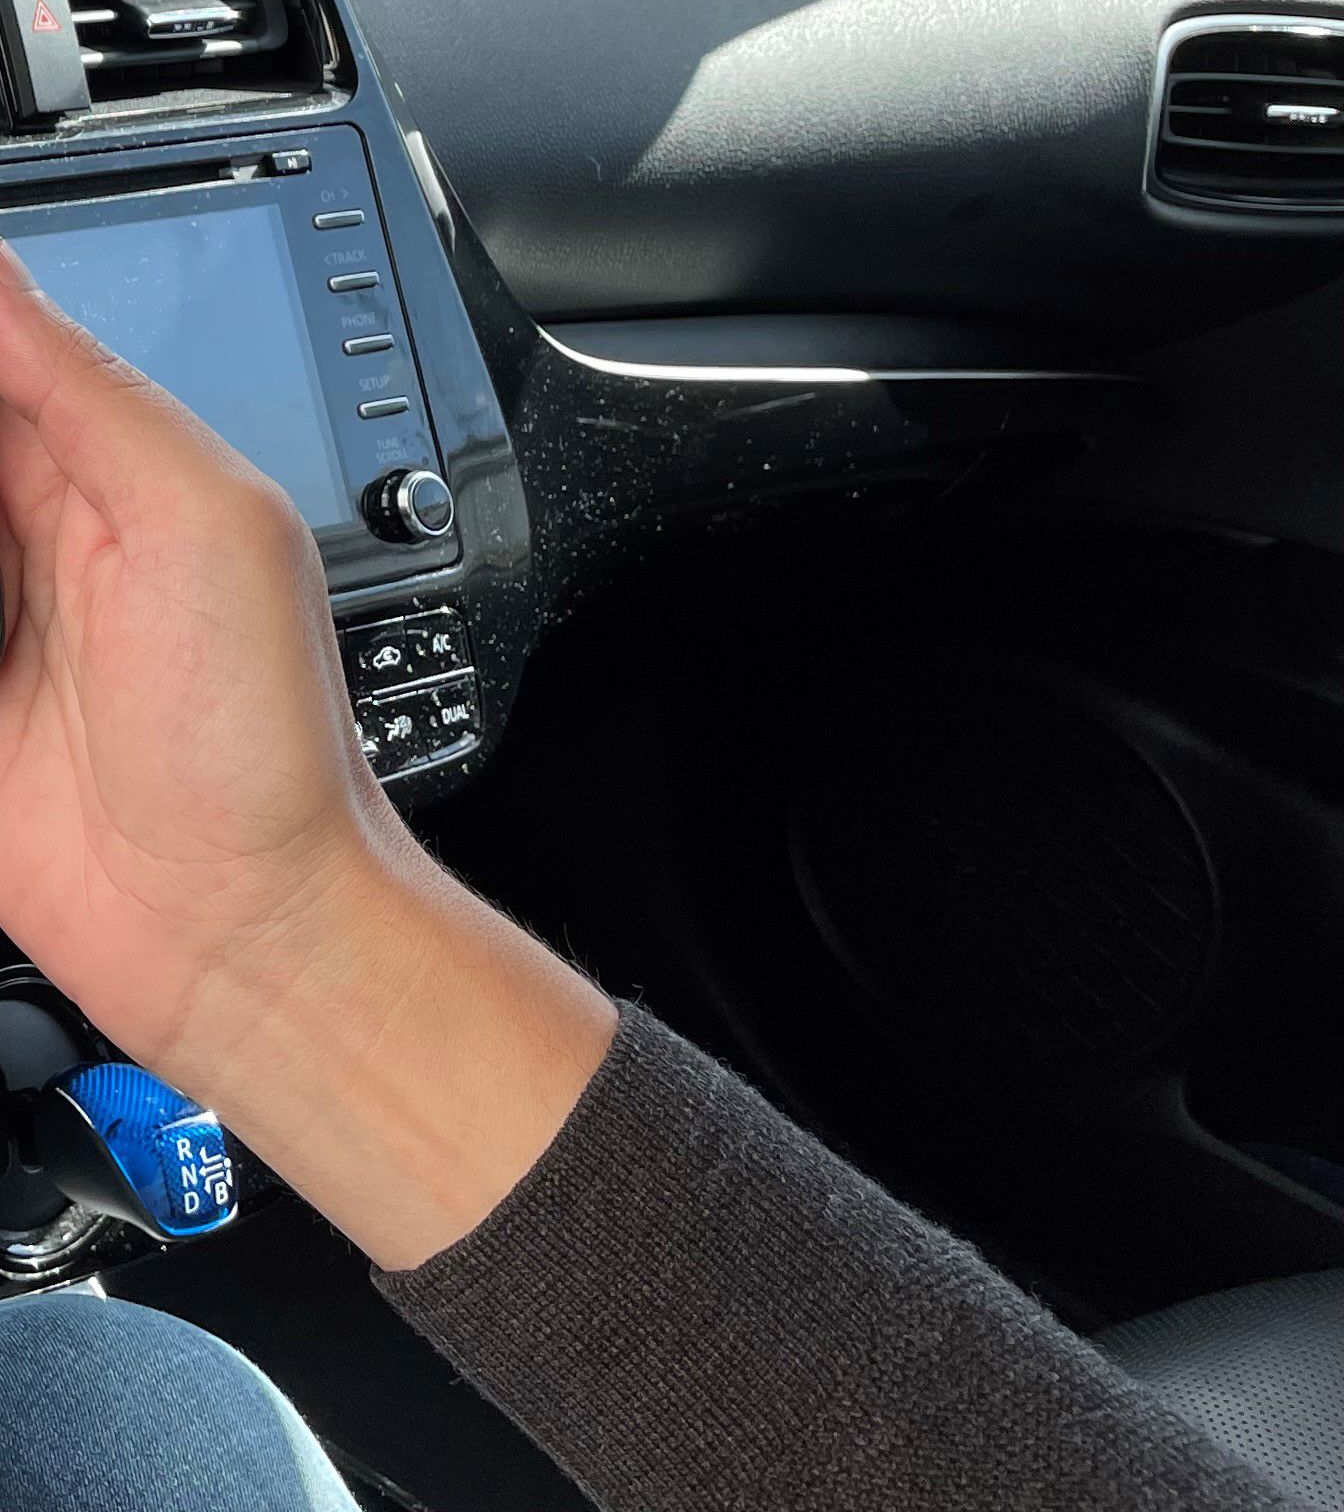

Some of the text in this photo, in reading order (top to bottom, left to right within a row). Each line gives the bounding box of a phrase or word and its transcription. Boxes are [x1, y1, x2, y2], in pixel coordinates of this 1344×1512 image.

[441, 703, 470, 725] DUAL
[176, 1138, 193, 1161] R
[180, 1164, 198, 1187] N
[184, 1191, 200, 1215] D
[214, 1181, 230, 1206] B
